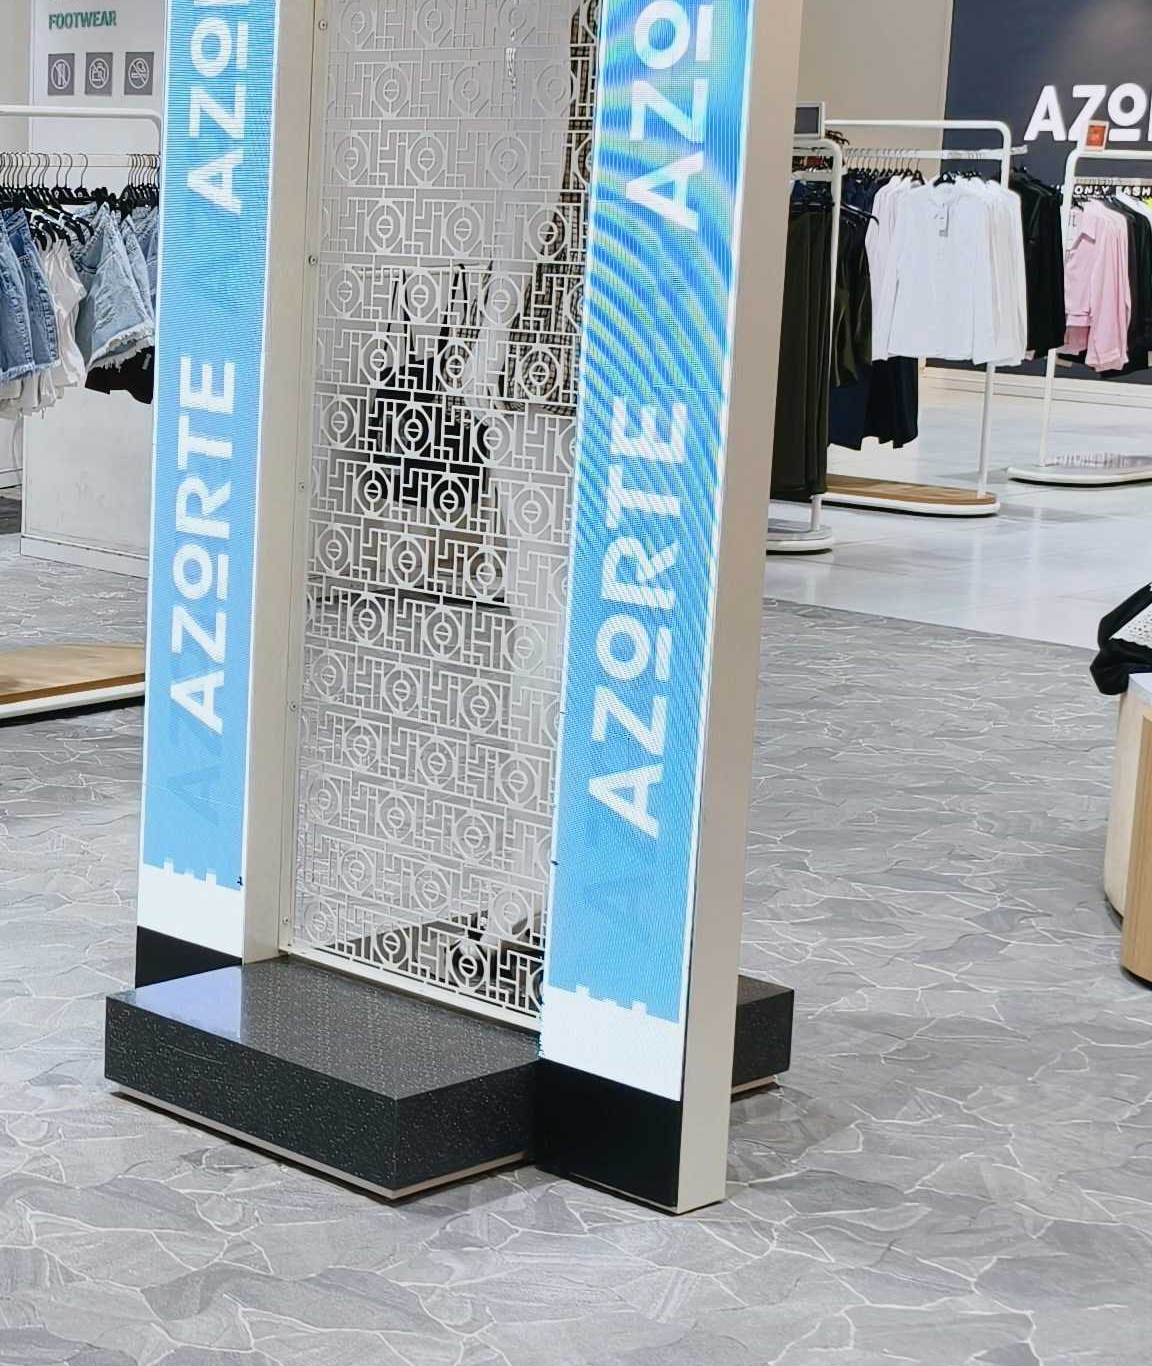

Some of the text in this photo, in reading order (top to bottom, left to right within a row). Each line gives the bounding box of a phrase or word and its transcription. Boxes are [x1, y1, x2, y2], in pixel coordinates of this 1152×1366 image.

[48, 10, 117, 30] FOOTWEAR
[1023, 83, 1152, 141] AZO
[1074, 185, 1109, 196] ONLY
[169, 354, 235, 736] AZORTE
[587, 396, 689, 838] AZORTE
